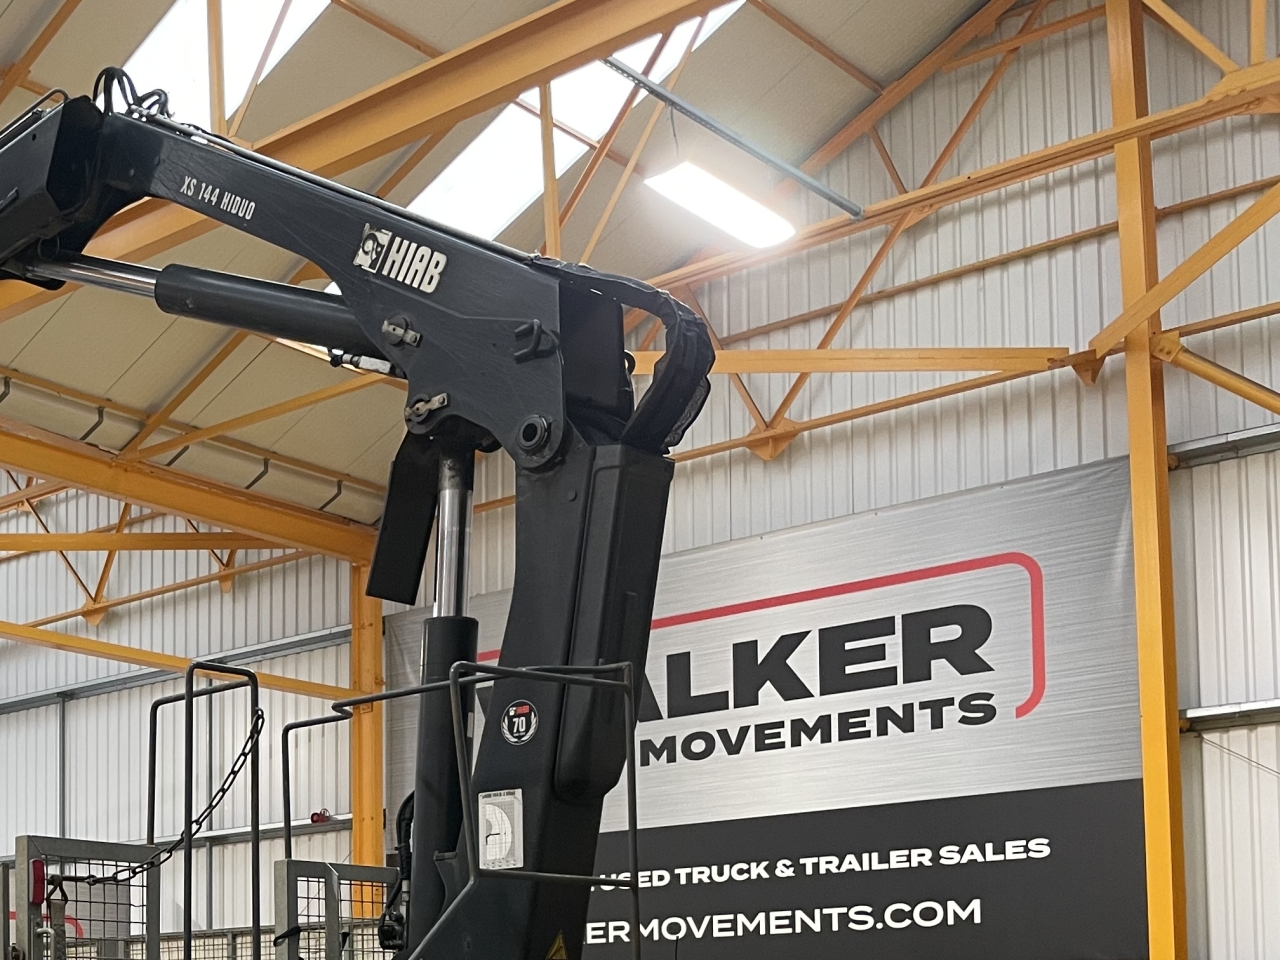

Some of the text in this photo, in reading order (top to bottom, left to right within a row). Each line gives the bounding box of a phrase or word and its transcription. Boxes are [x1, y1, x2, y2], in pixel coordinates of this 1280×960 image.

[180, 175, 256, 220] XS 144 HIDUO
[381, 236, 448, 294] HIAB
[513, 716, 526, 733] 70
[639, 691, 997, 768] MOVEMENTS
[674, 860, 770, 885] TRUCK
[774, 858, 796, 878] &
[799, 847, 933, 876] TRAILER
[938, 837, 1052, 866] SALES
[584, 898, 982, 945] ERMOVEMENTS.COM
